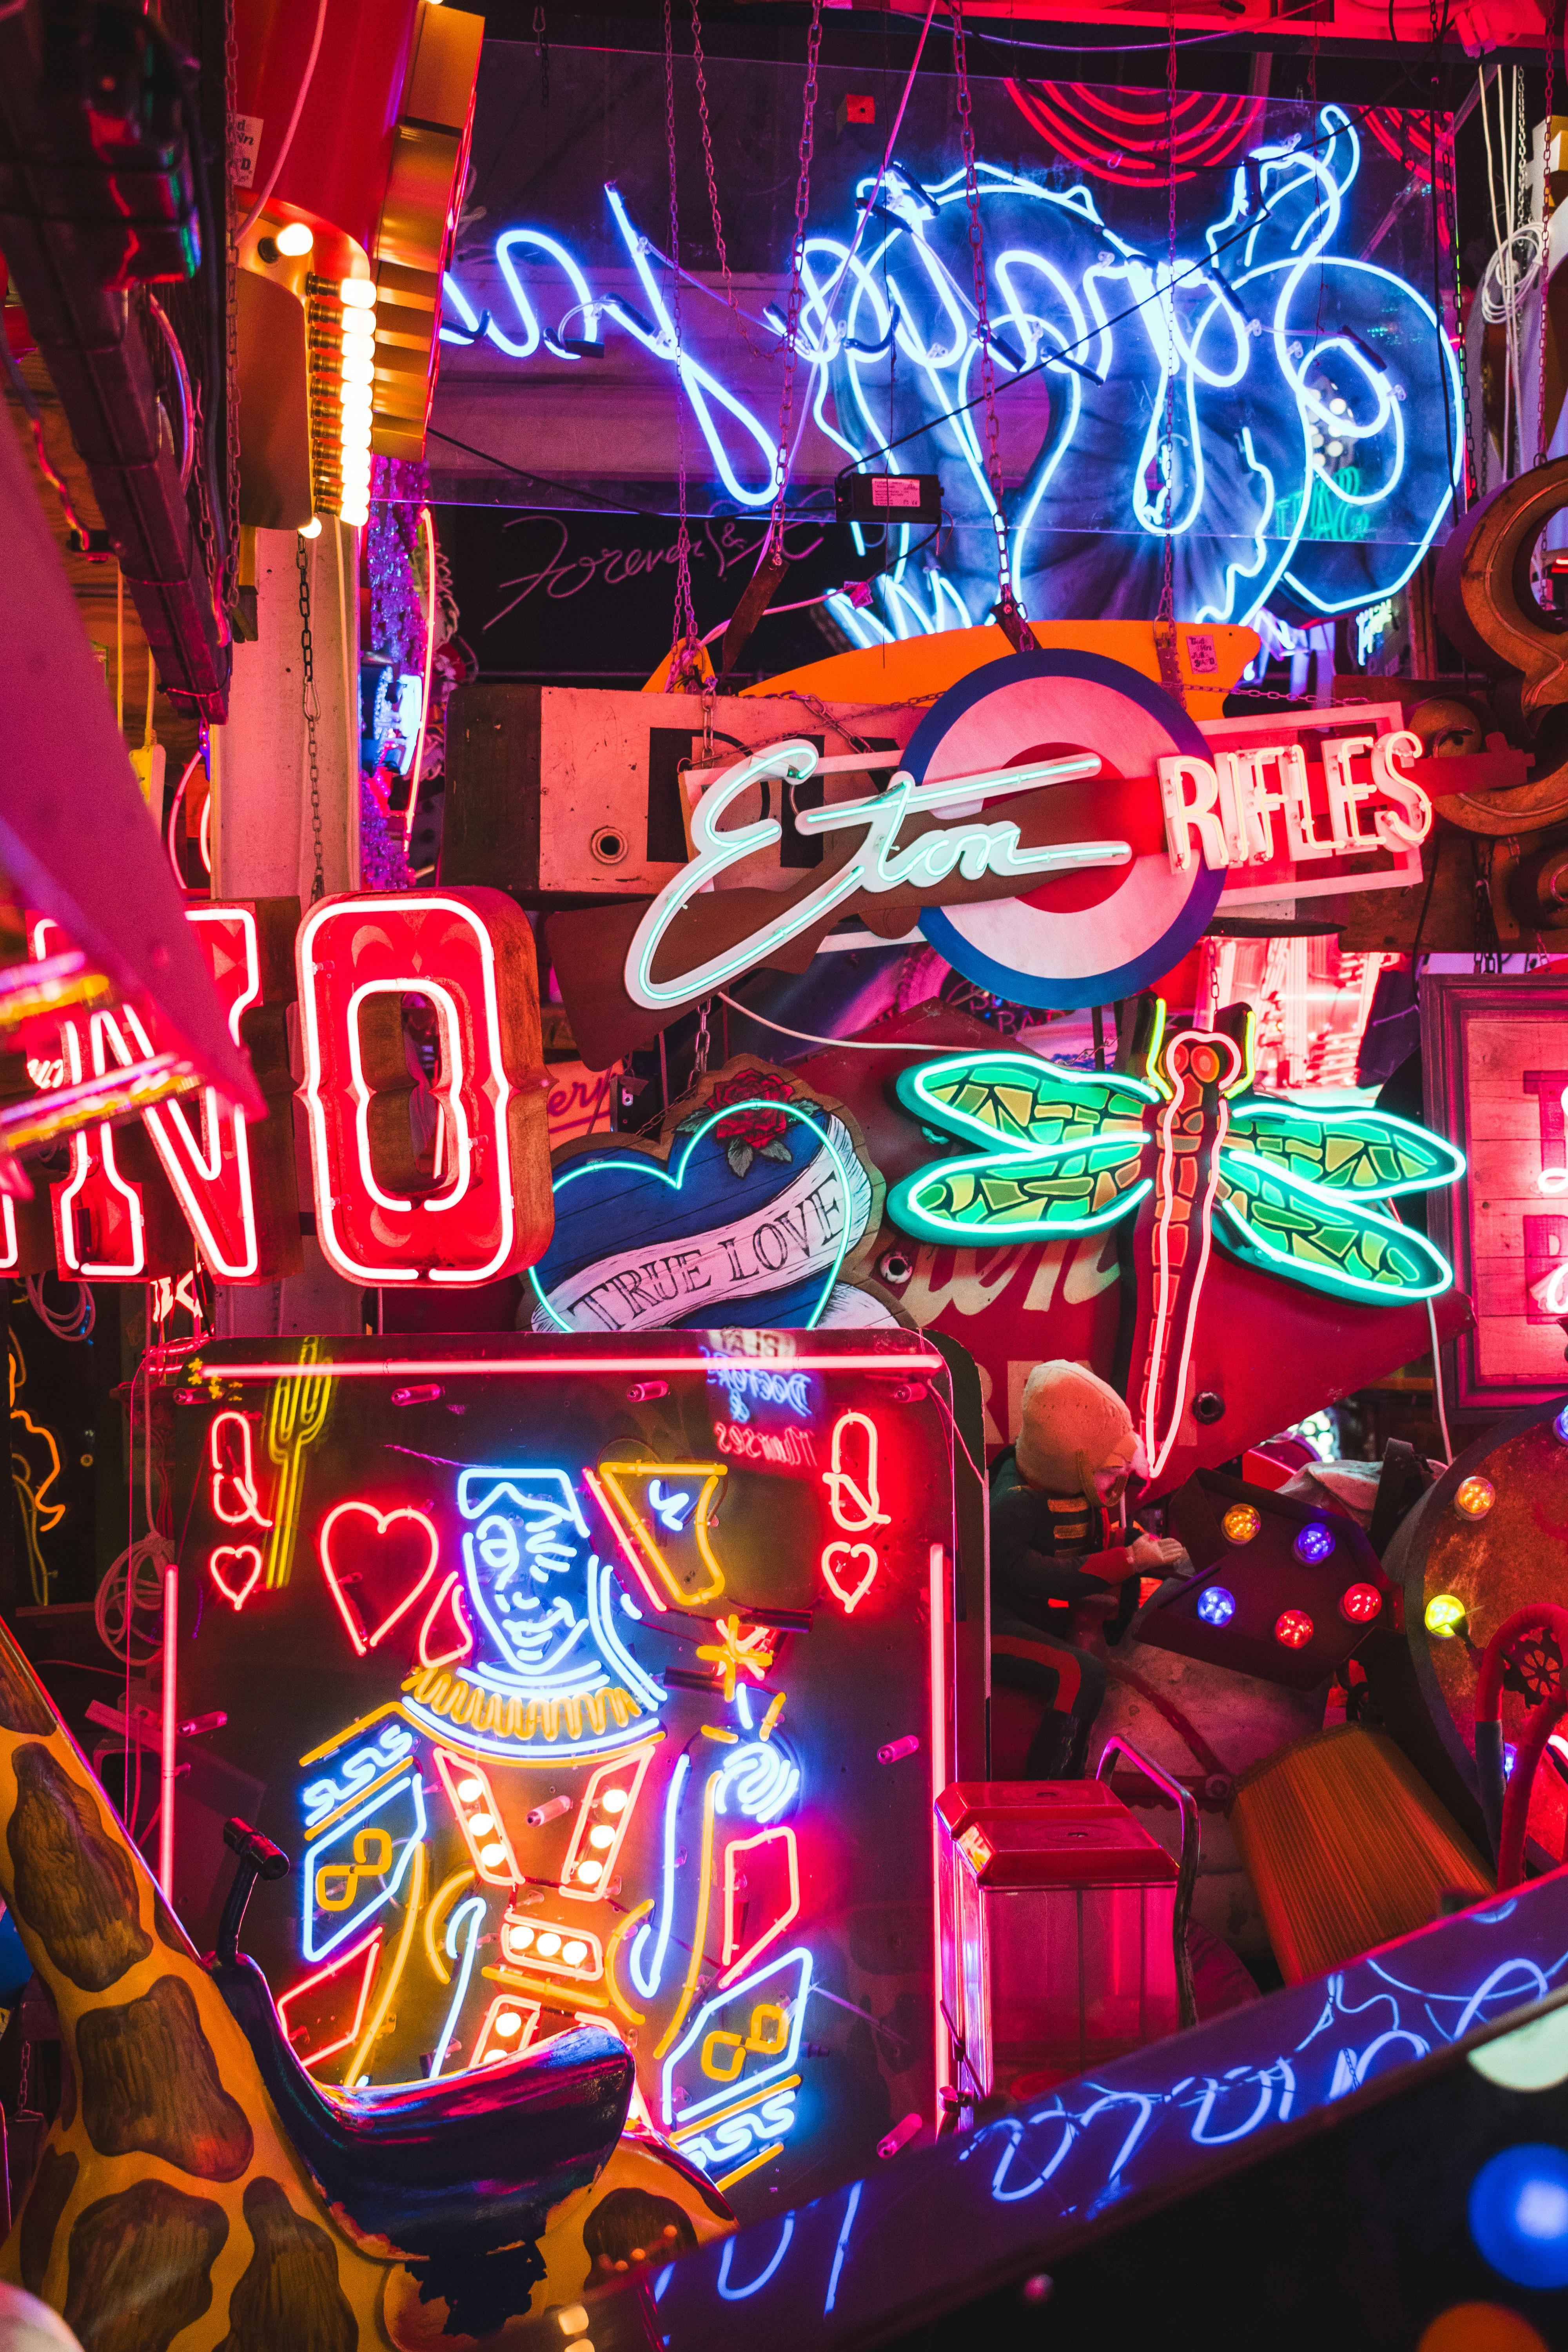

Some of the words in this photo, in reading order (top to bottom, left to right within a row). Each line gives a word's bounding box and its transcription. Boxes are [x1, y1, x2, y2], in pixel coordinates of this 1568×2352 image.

[624, 739, 1132, 1009] Eton
[1157, 730, 1432, 874] RIFLES
[567, 1249, 711, 1330] TRUE
[718, 1170, 844, 1281] LOVE
[211, 1412, 273, 1526] Q
[822, 1411, 892, 1532] Q
